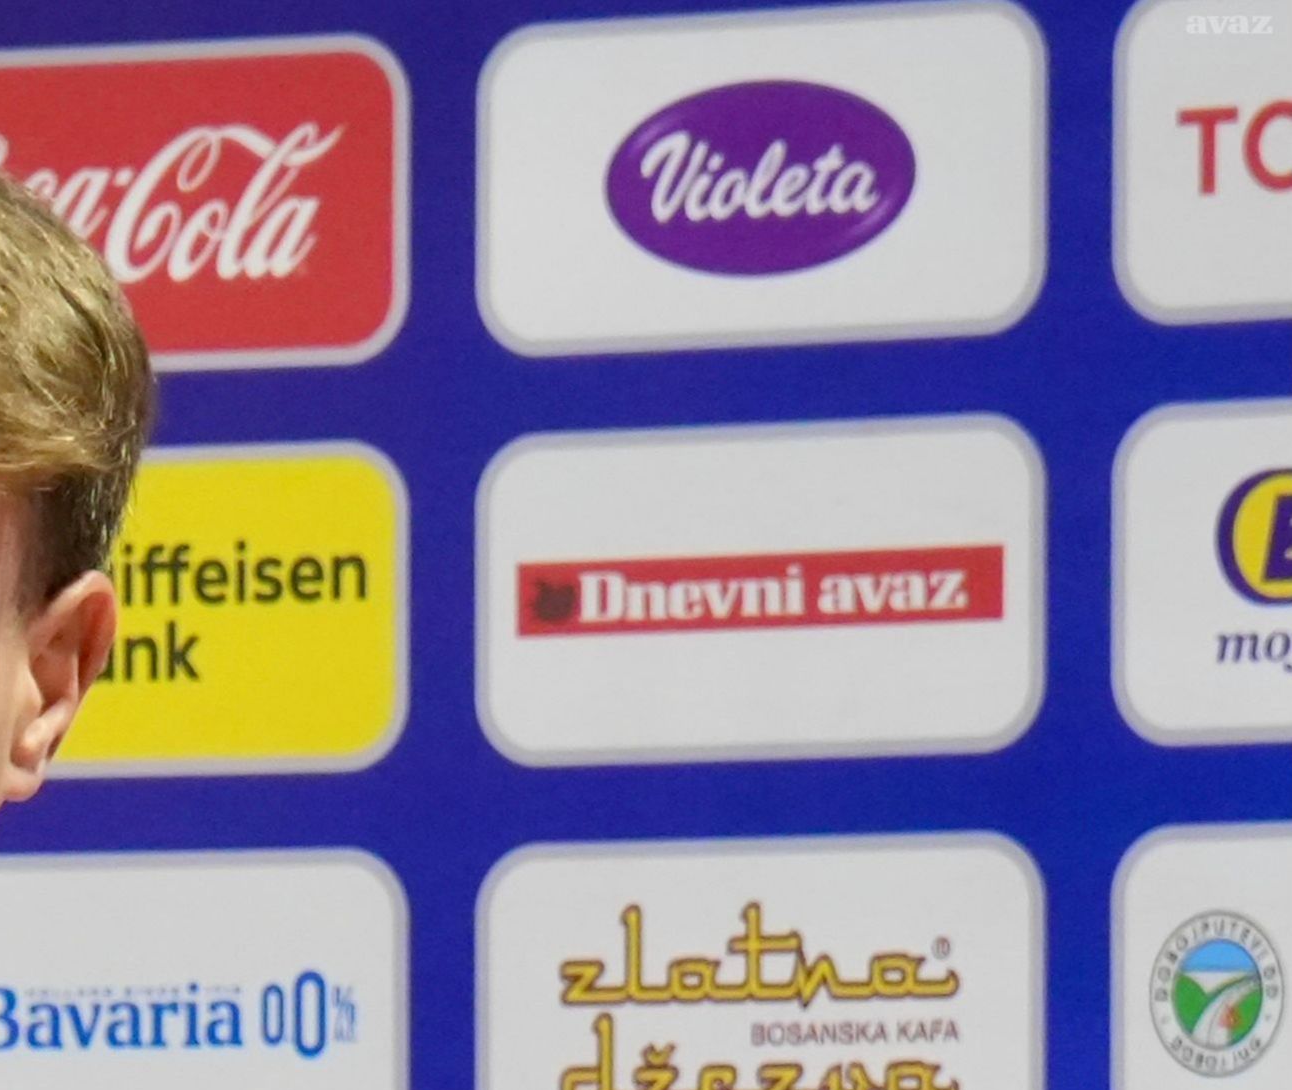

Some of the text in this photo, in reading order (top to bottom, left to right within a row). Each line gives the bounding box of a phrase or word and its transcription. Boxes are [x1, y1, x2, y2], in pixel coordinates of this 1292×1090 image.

[641, 130, 880, 223] Violeta
[121, 542, 369, 606] iffeisen
[579, 564, 968, 623] Dnevni avaz
[559, 903, 959, 1007] zlatna
[750, 1020, 959, 1045] BOSANSKA KAFA
